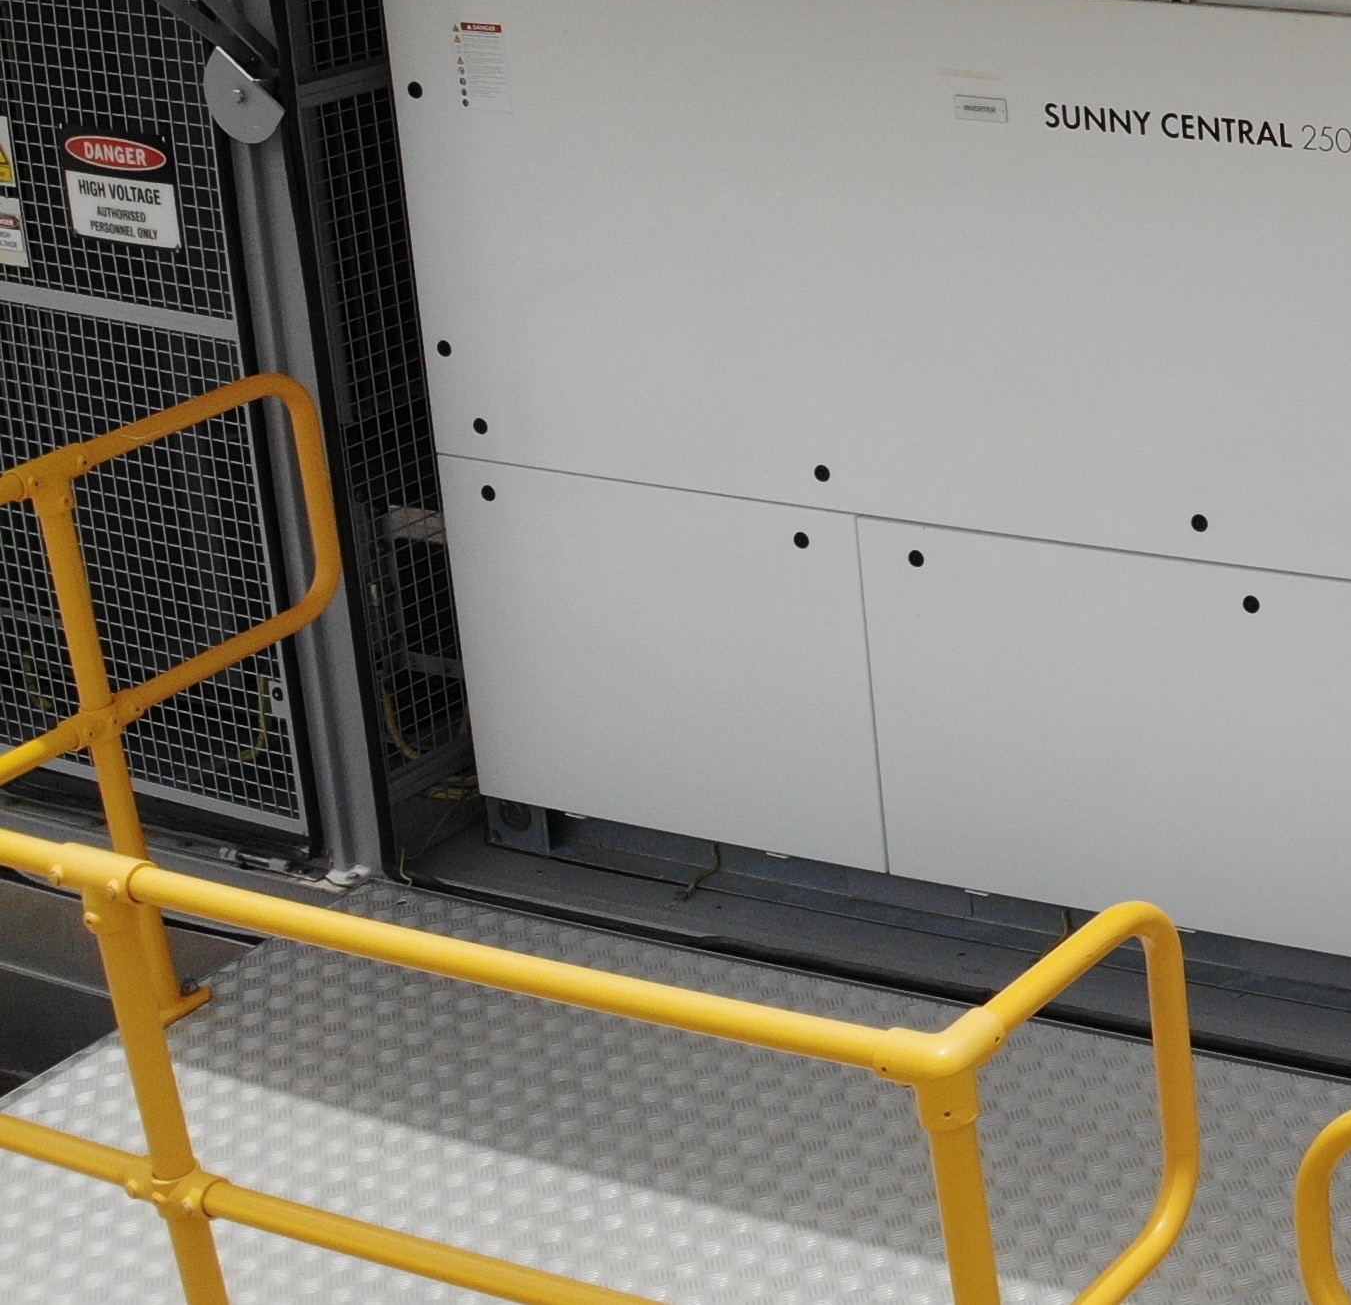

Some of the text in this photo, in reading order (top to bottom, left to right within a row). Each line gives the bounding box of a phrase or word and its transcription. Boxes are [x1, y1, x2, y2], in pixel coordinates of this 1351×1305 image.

[1044, 102, 1151, 135] SUNNY
[1160, 112, 1293, 149] CENTRAL
[84, 141, 147, 166] DANGER
[78, 178, 162, 206] HIGH VOLTAGE
[97, 205, 147, 223] AUTHORISED
[90, 220, 158, 240] PERSONNEL ONLY
